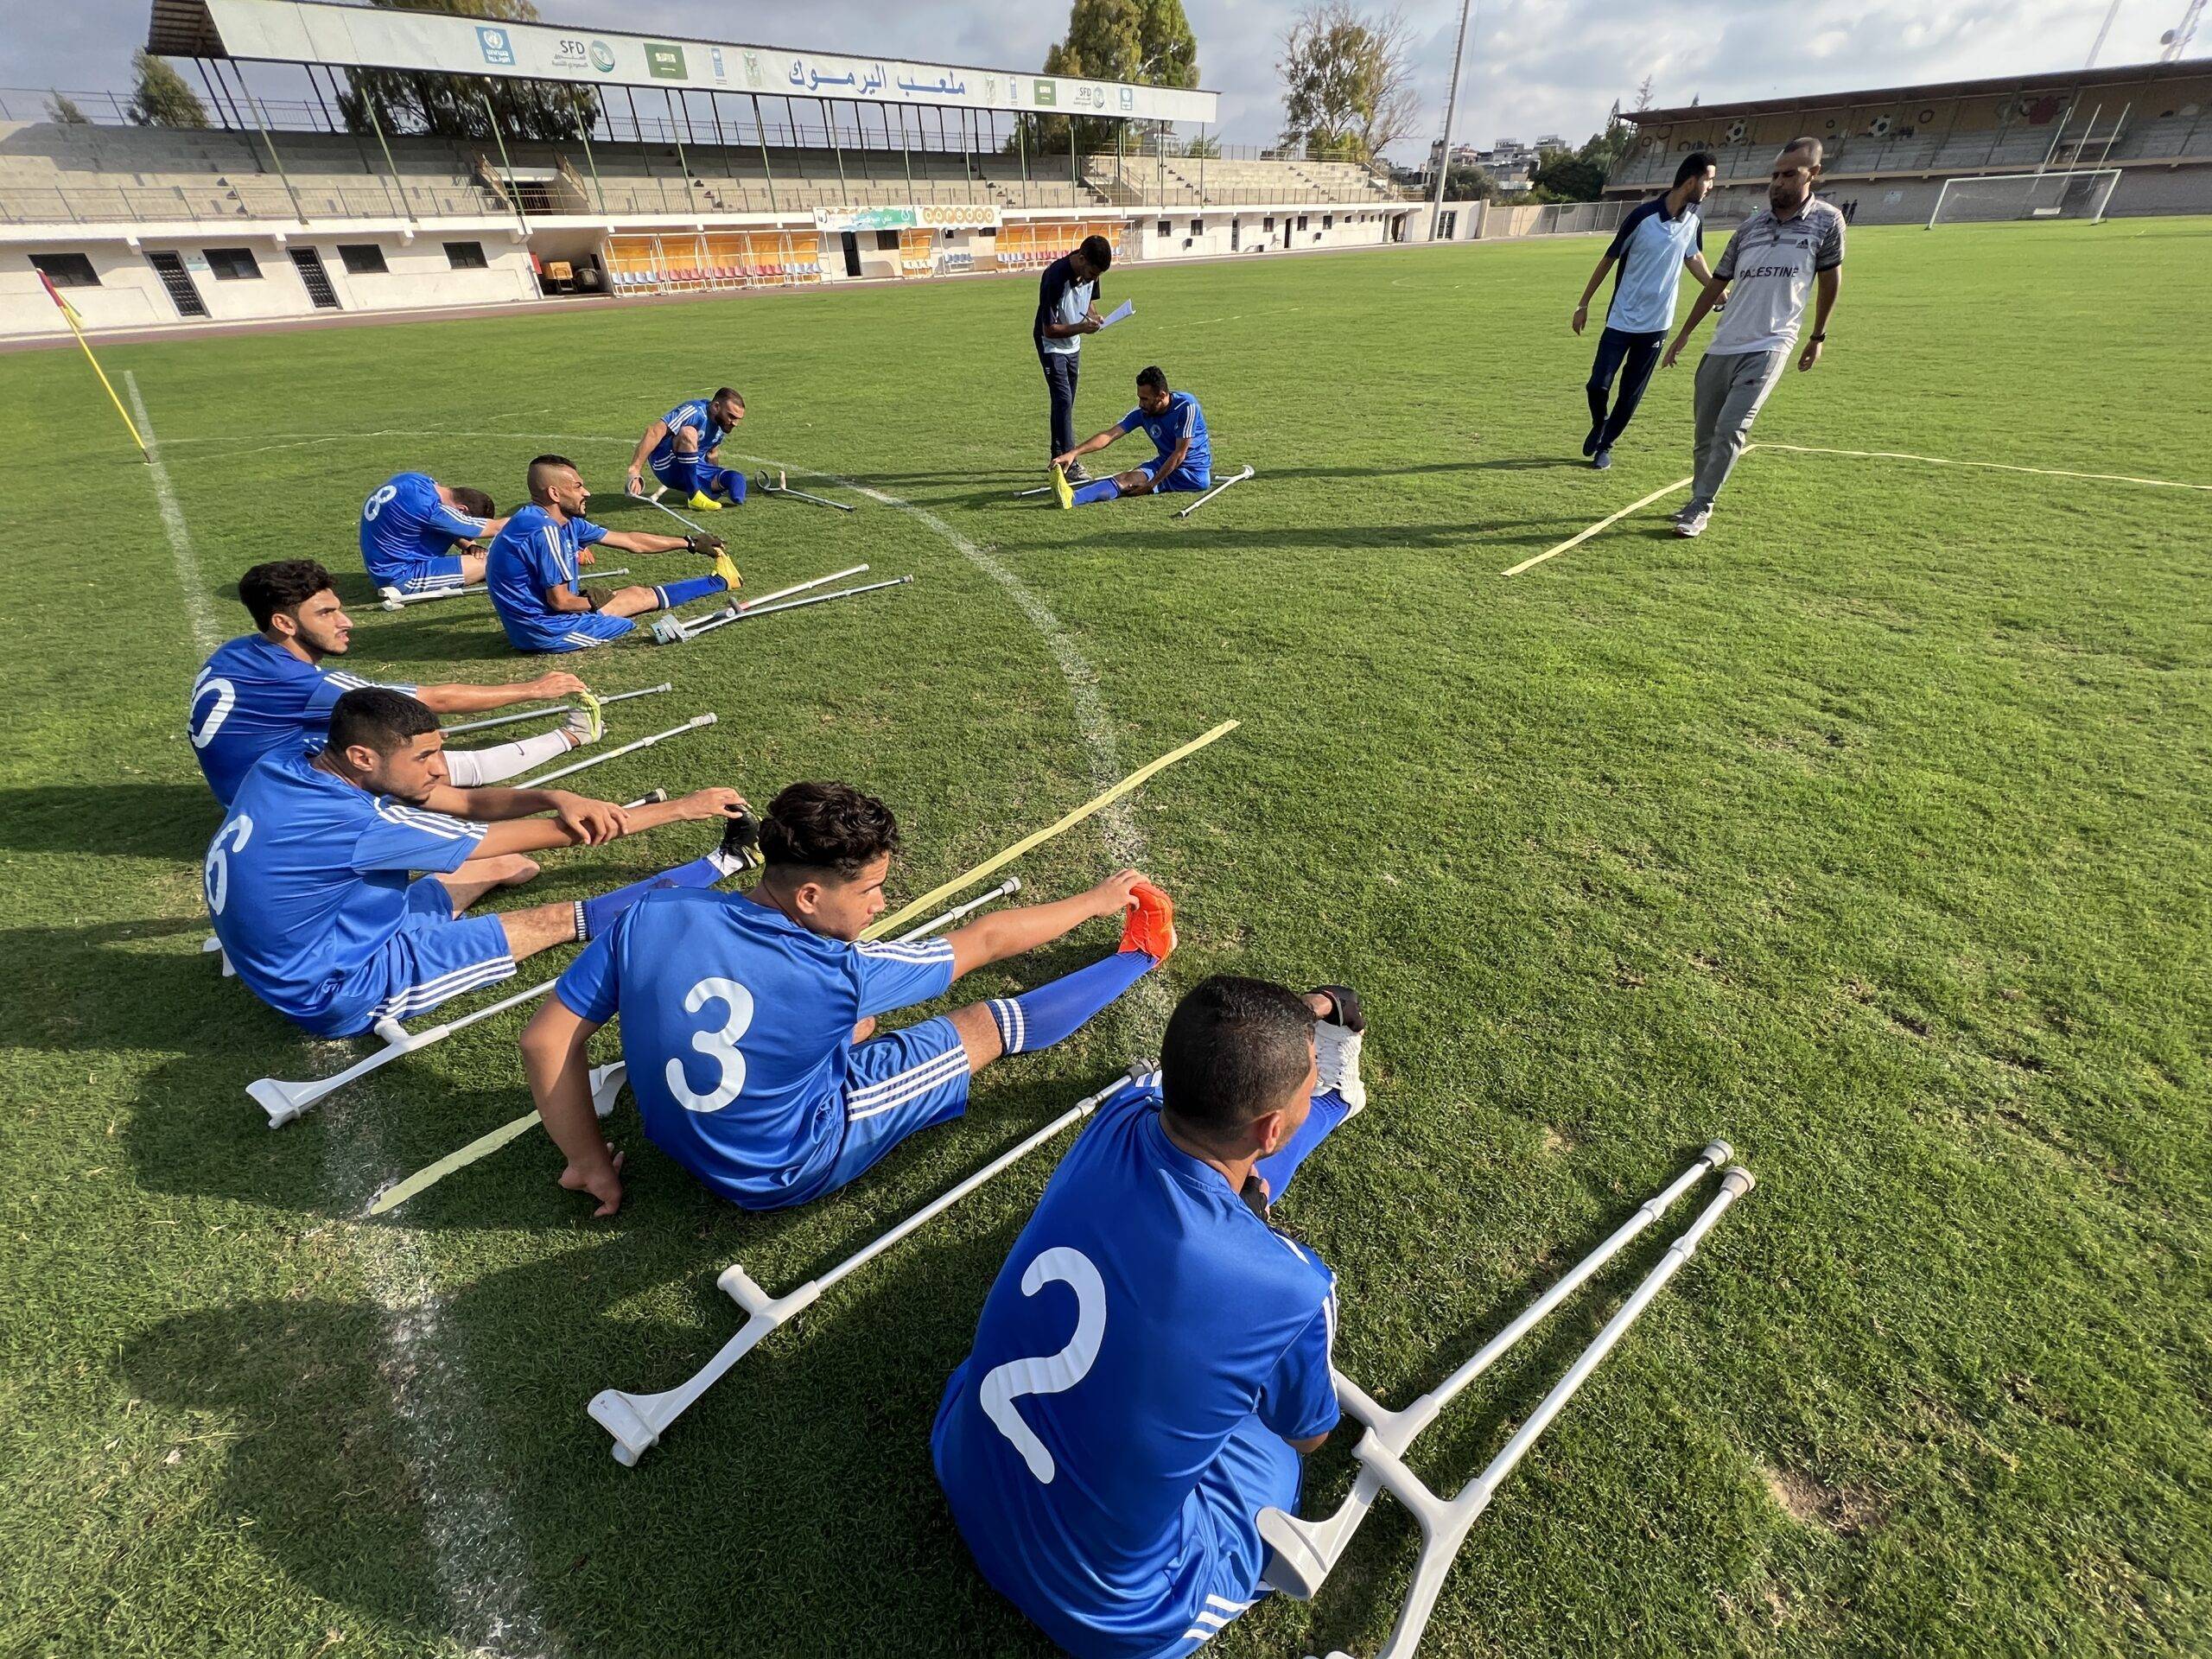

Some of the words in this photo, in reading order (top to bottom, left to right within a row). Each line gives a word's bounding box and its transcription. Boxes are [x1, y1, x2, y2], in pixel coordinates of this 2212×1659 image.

[560, 41, 585, 54] SFD
[789, 59, 887, 95] اليرموك
[897, 70, 966, 97] ملعب
[1739, 266, 1799, 280] PALESTINE
[364, 485, 397, 522] 8
[205, 815, 254, 916] 6
[665, 976, 754, 1113] 3
[980, 1246, 1107, 1484] 2
